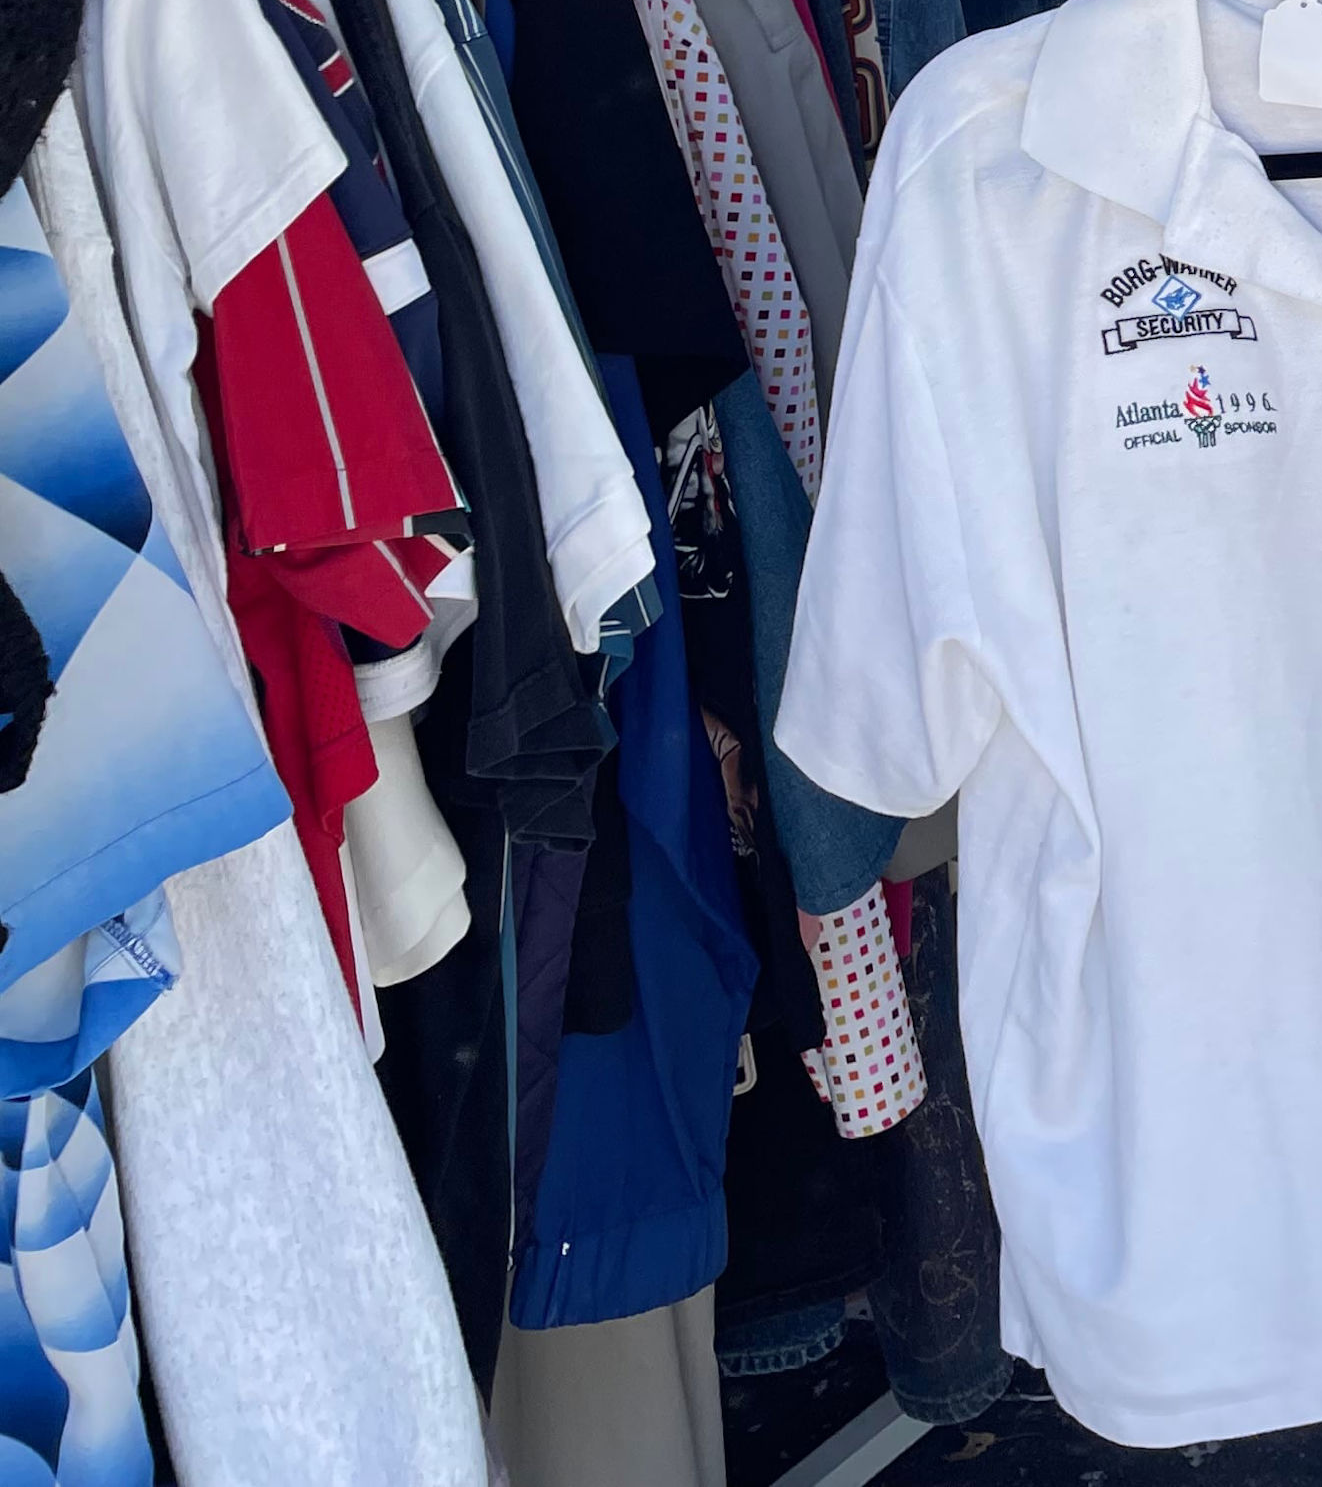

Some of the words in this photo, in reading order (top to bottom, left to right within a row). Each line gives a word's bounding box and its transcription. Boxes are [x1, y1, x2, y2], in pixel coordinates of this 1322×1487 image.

[1137, 312, 1224, 337] SECURITY
[1115, 399, 1184, 429] Atlanta
[1215, 392, 1278, 414] 1996
[1124, 430, 1182, 450] OFFICIAL
[1223, 421, 1277, 435] SPONSOR
